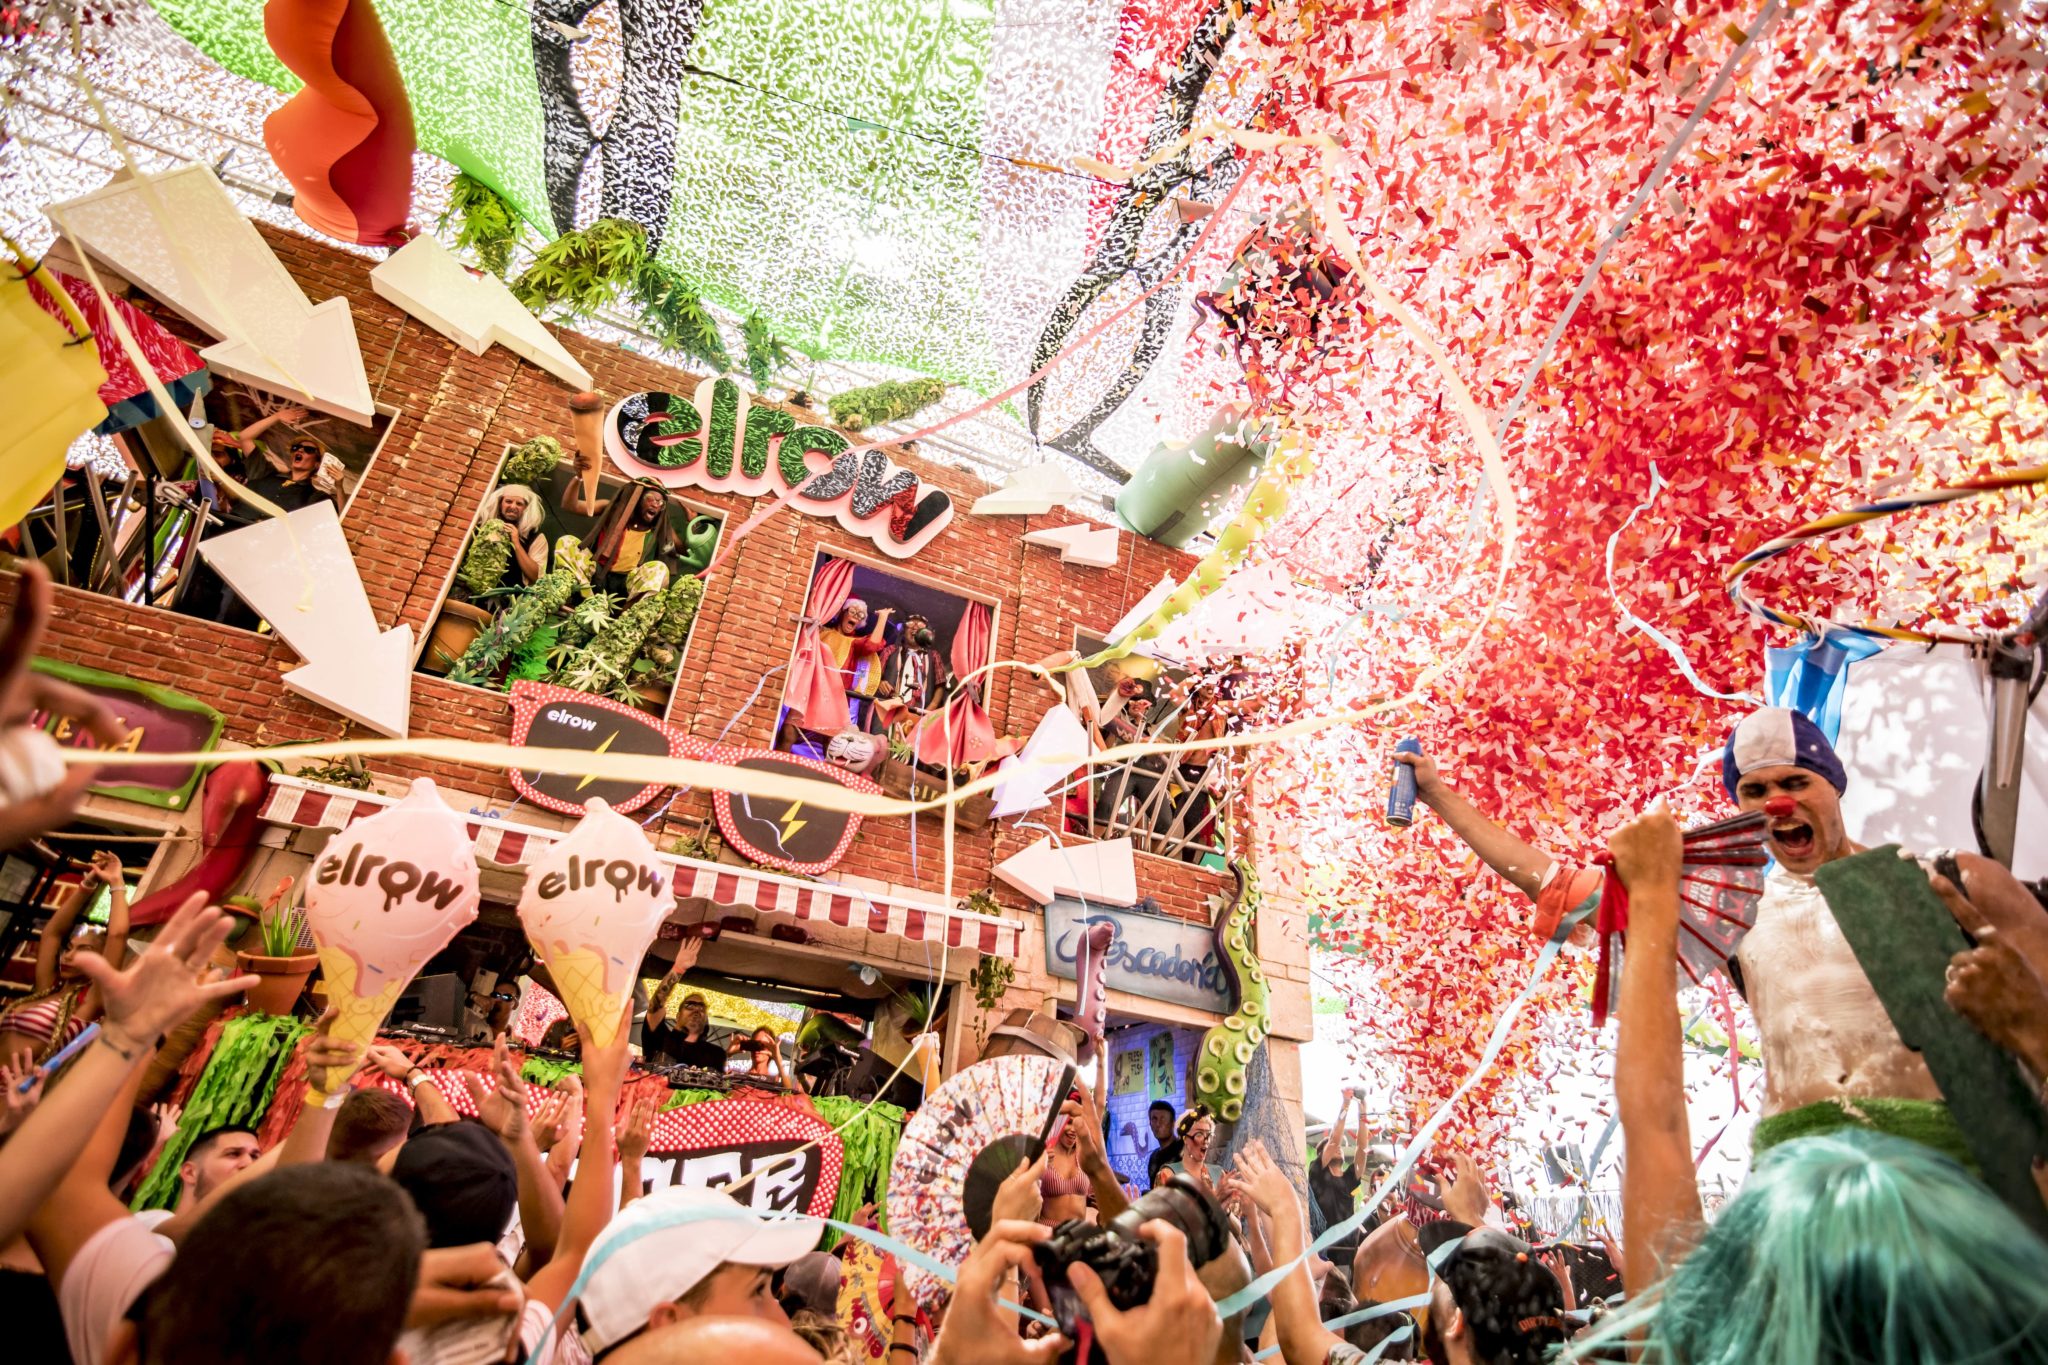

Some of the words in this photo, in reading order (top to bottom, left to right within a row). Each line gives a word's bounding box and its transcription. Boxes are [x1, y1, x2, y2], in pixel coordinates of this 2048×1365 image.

[615, 375, 952, 549] elrow
[547, 708, 597, 731] elrow
[316, 842, 464, 912] elrow
[538, 854, 665, 903] elrow
